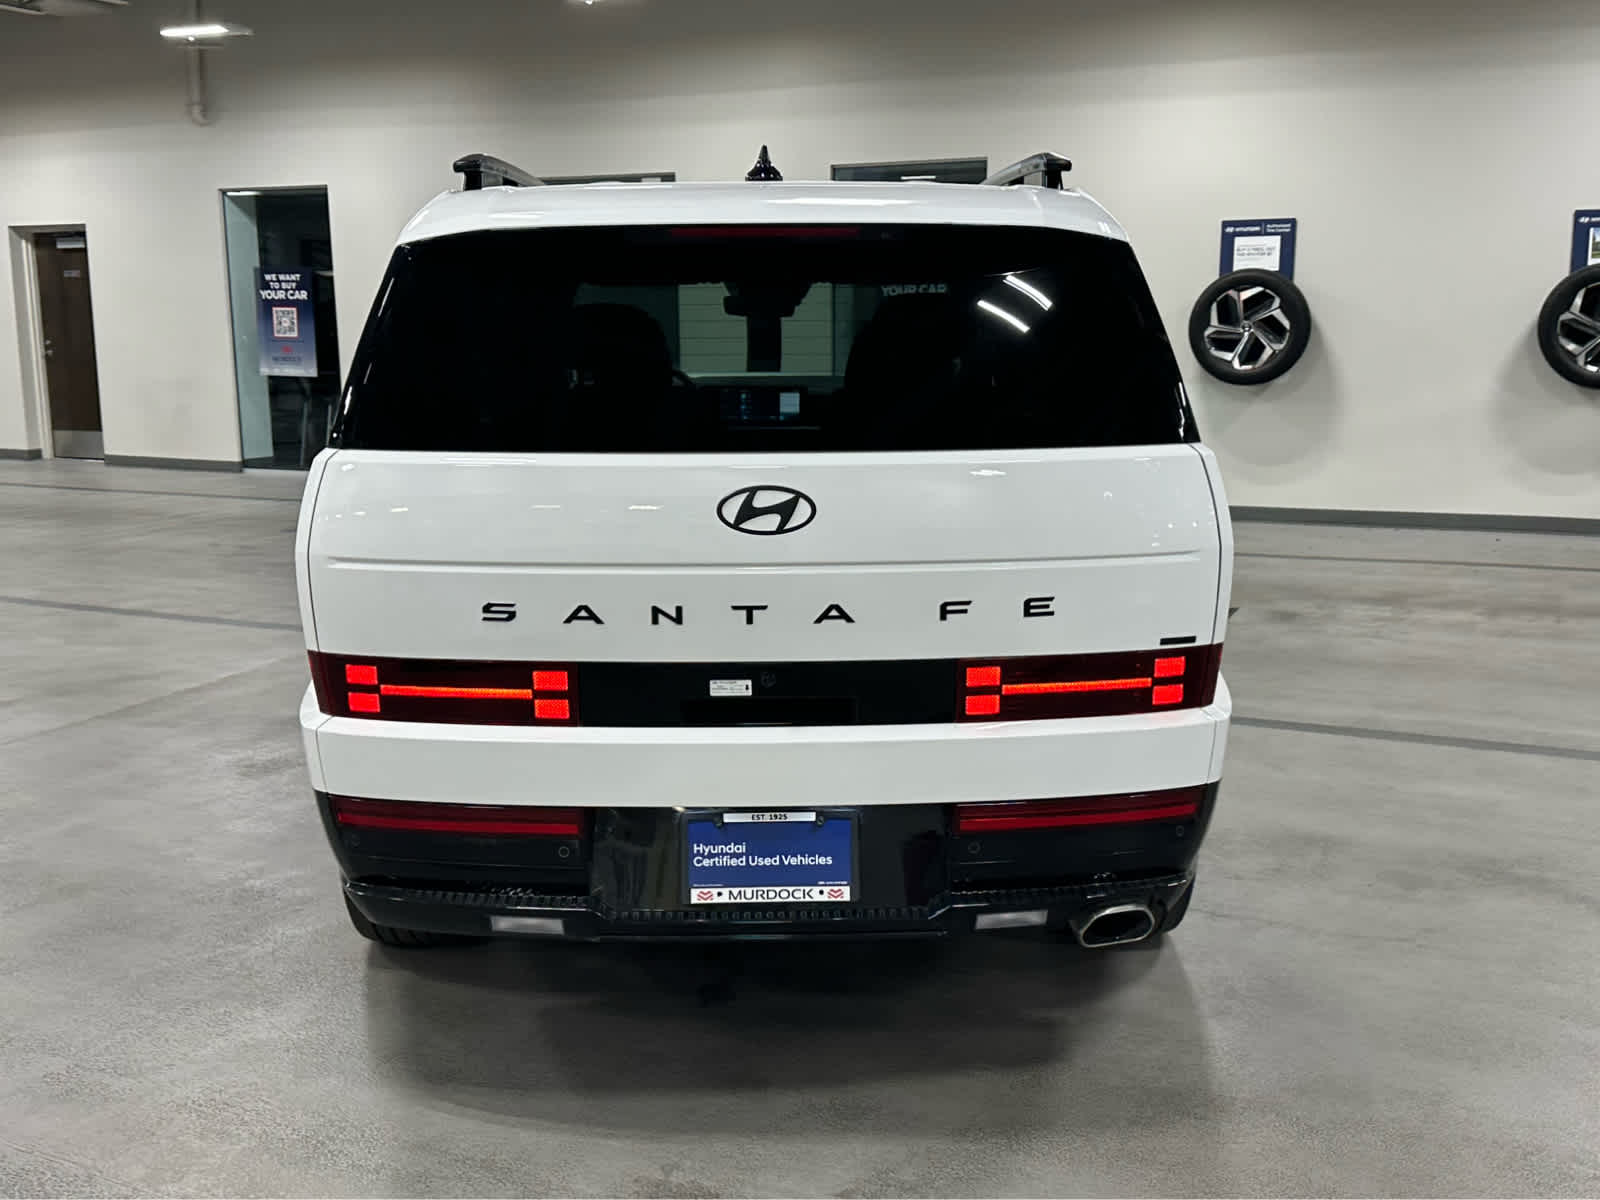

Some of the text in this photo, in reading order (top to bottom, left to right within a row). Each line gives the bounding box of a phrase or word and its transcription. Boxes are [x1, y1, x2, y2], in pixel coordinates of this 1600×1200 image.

[264, 273, 301, 281] WE WANT
[260, 289, 308, 300] YOUR CAR
[481, 596, 1056, 626] SANTA FE
[769, 813, 788, 821] 1925
[693, 842, 747, 857] Hyundai
[692, 853, 833, 868] Certified Used Vehicles
[728, 888, 814, 901] MURDOCK
